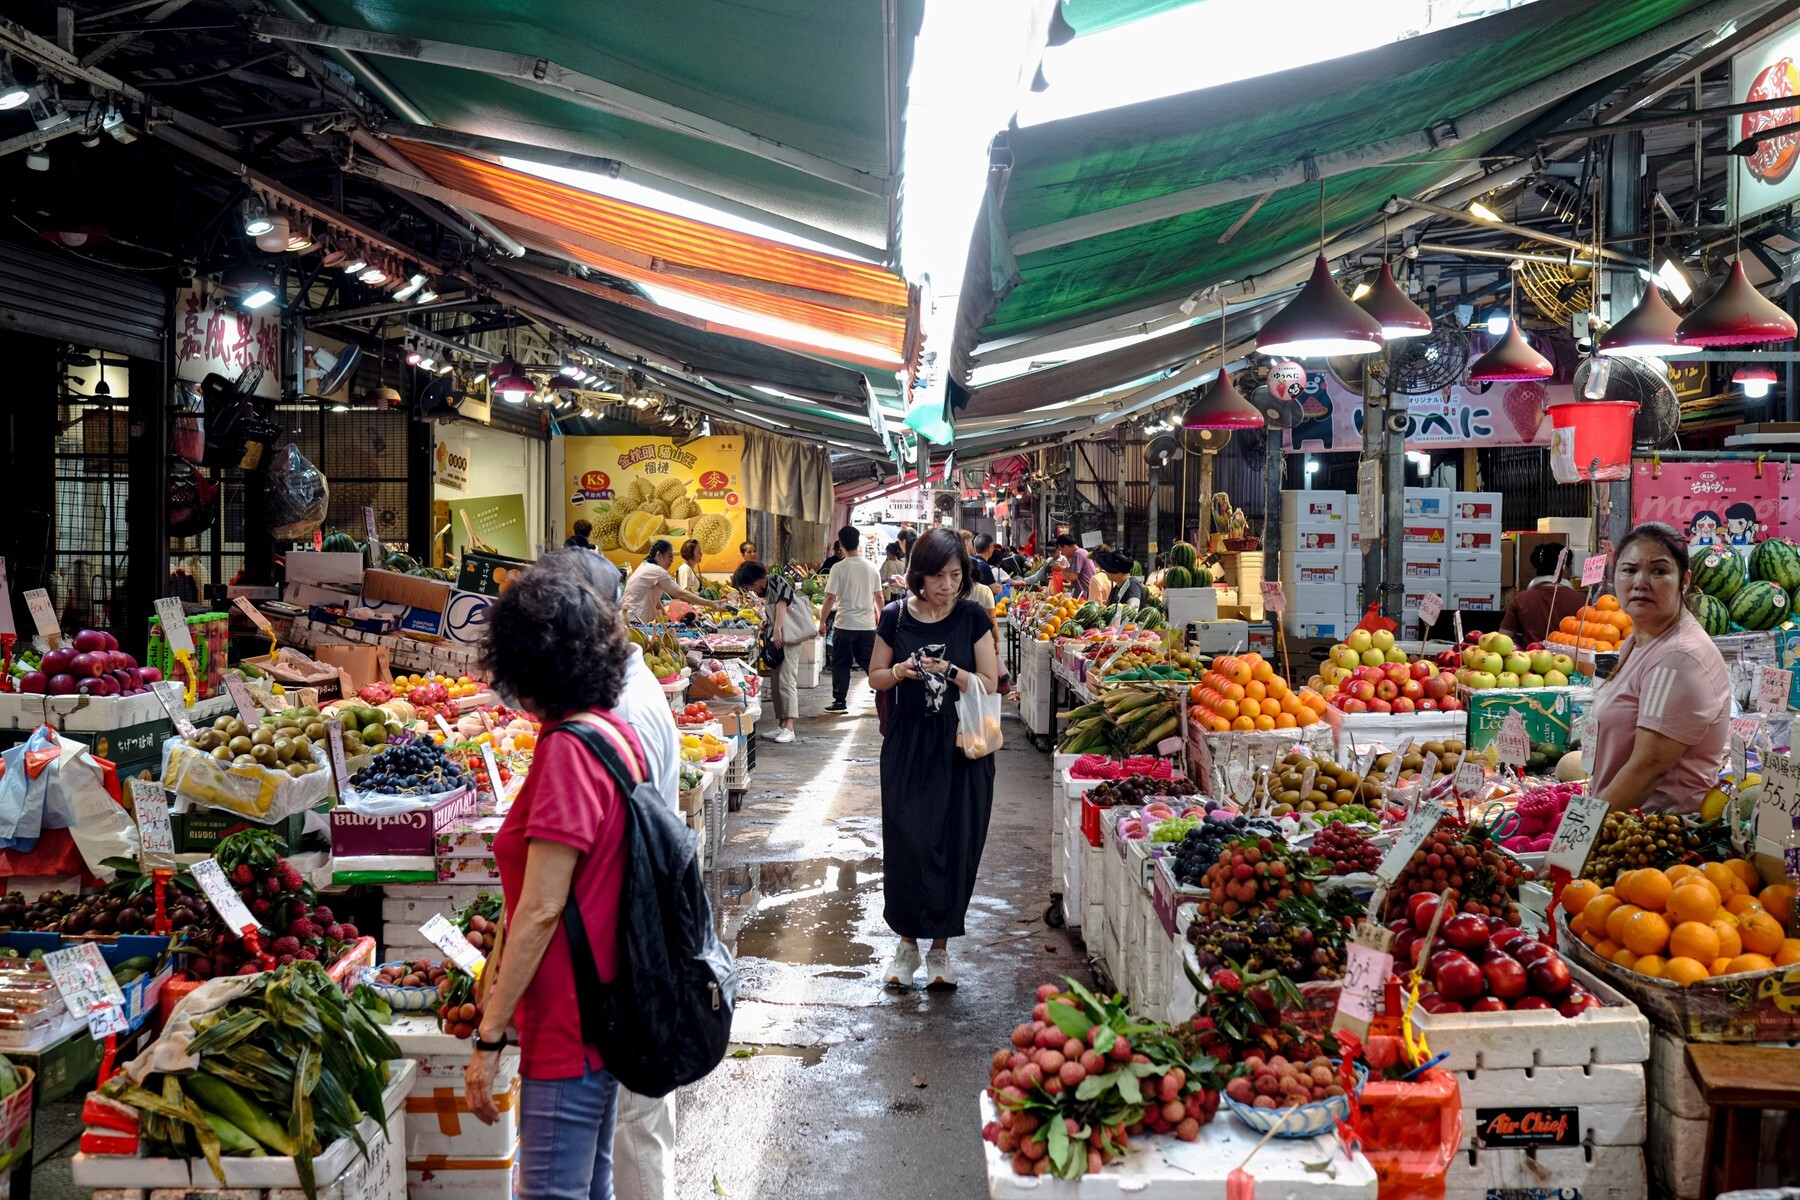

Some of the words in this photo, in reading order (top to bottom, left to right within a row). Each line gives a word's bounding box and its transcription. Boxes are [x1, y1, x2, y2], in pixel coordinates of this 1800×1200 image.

[618, 444, 656, 471] 金枕頭
[658, 444, 698, 470] 貓山王
[586, 474, 606, 486] KS
[888, 503, 925, 511] CHERRIES
[1486, 1112, 1519, 1134] Air
[1521, 1111, 1568, 1141] Chief
